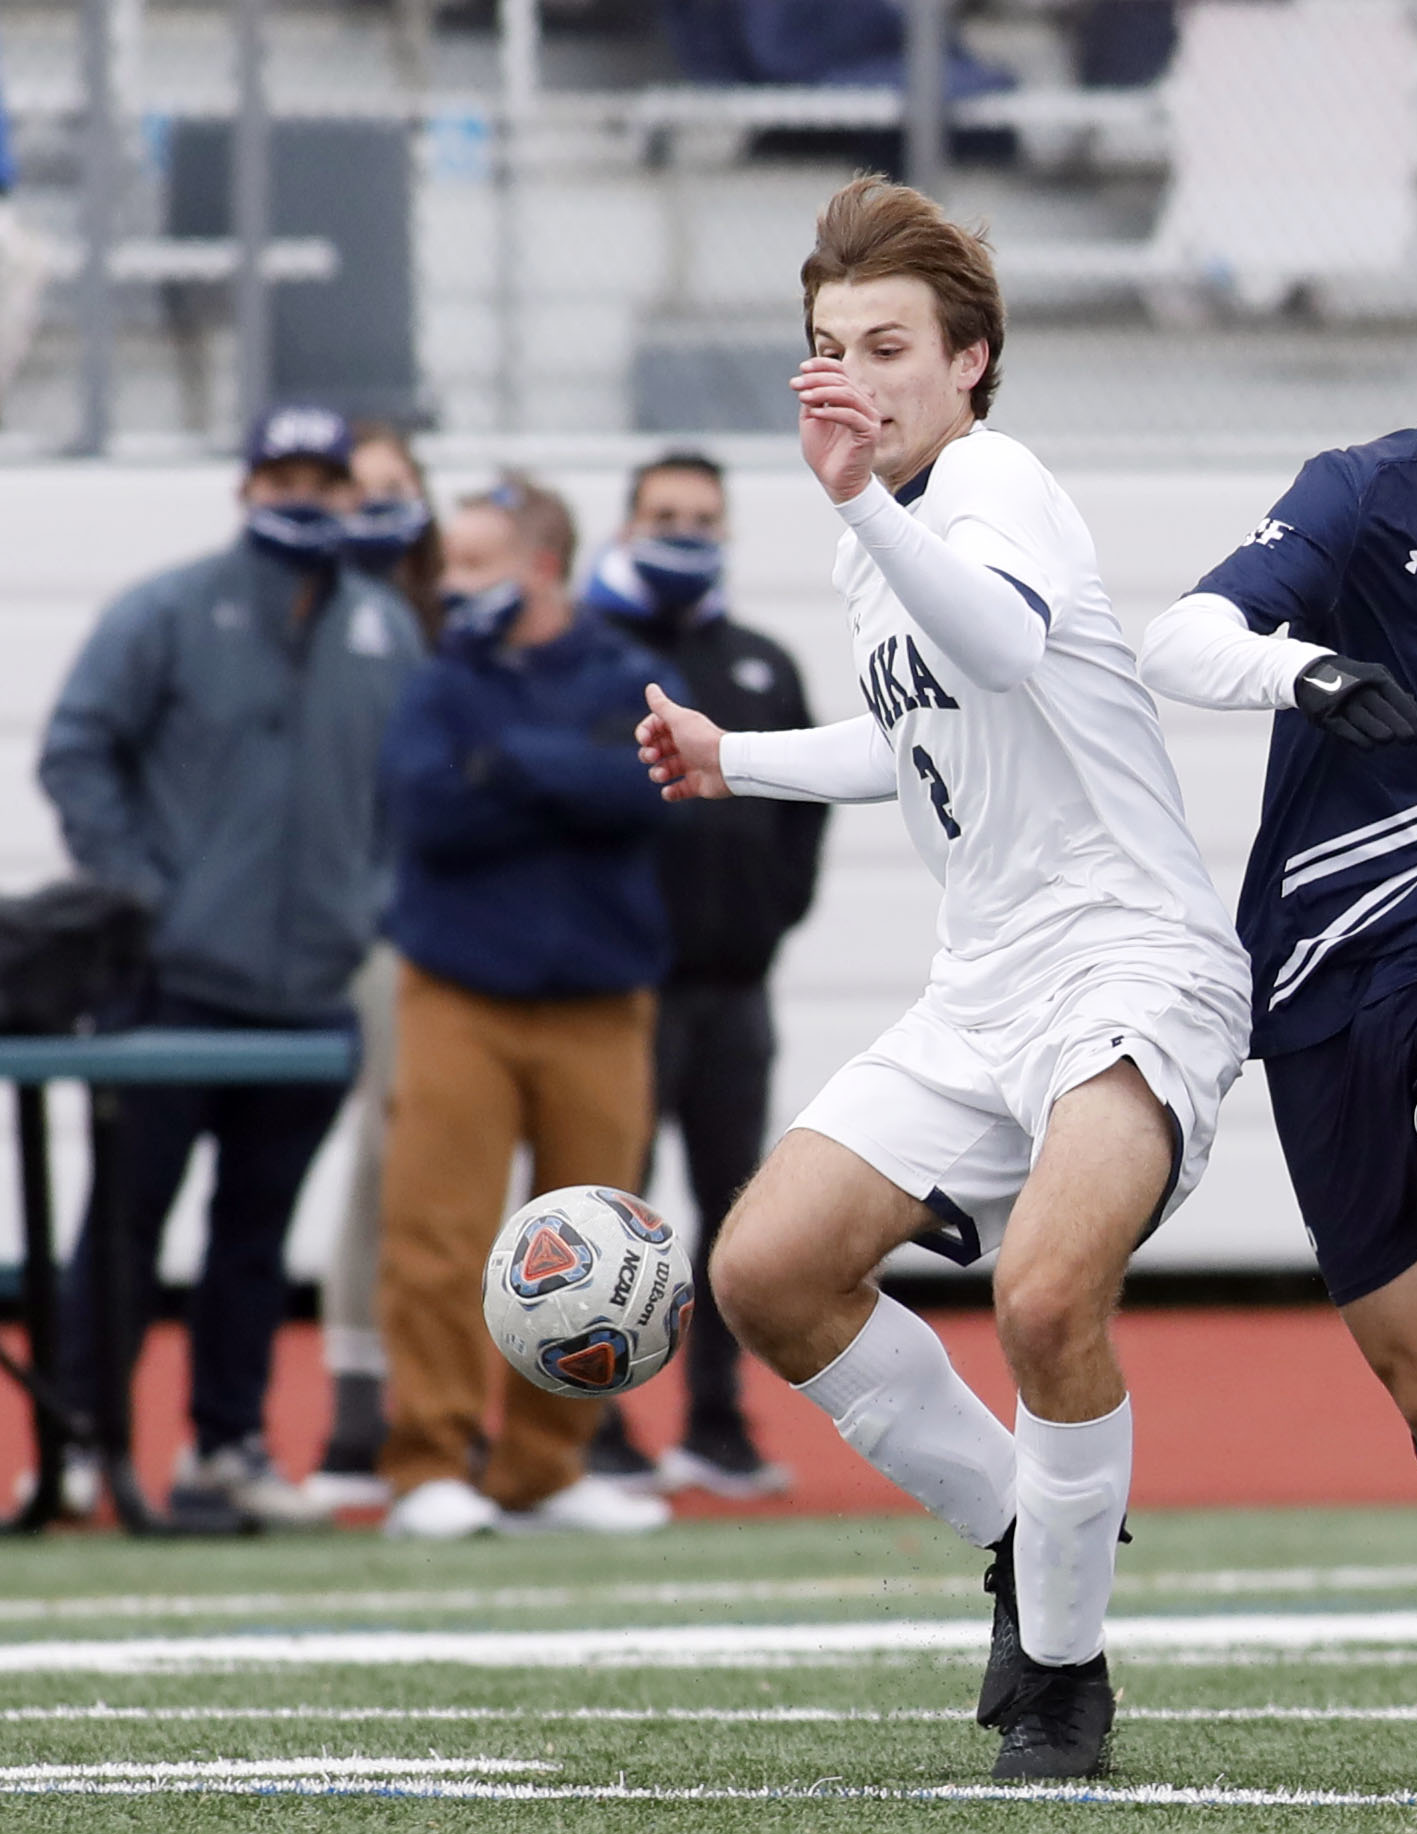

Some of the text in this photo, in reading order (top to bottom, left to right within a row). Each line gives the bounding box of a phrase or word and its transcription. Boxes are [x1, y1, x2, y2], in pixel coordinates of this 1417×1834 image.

[912, 744, 961, 840] 2
[609, 1248, 641, 1307] NCAA
[637, 1261, 670, 1326] Wilson
